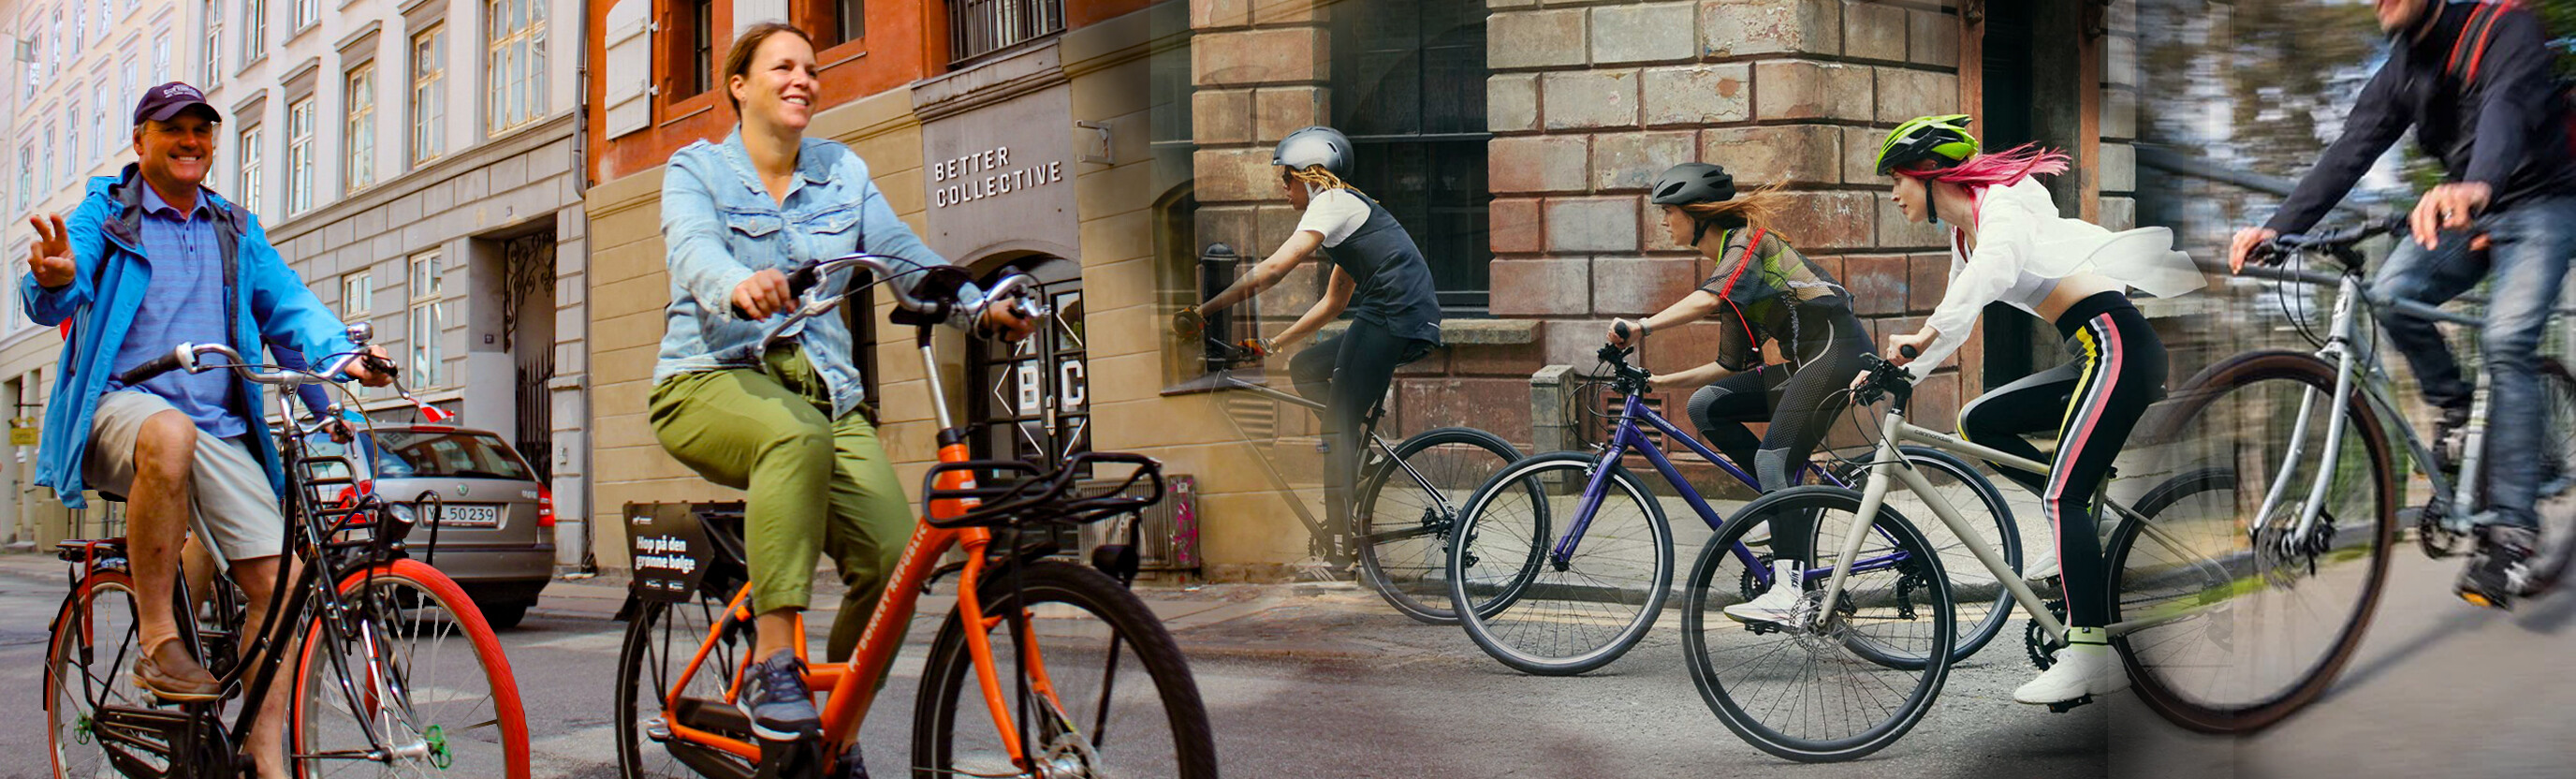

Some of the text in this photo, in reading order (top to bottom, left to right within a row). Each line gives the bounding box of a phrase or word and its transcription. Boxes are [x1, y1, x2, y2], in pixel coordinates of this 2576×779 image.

[935, 146, 1009, 183] BETTER
[936, 161, 1062, 208] COLLECTIVE
[1914, 429, 1954, 443] cannondale
[428, 507, 494, 522] Y 50 239
[637, 535, 686, 554] Hop på den
[859, 523, 928, 651] DONKEY REPUBLIC
